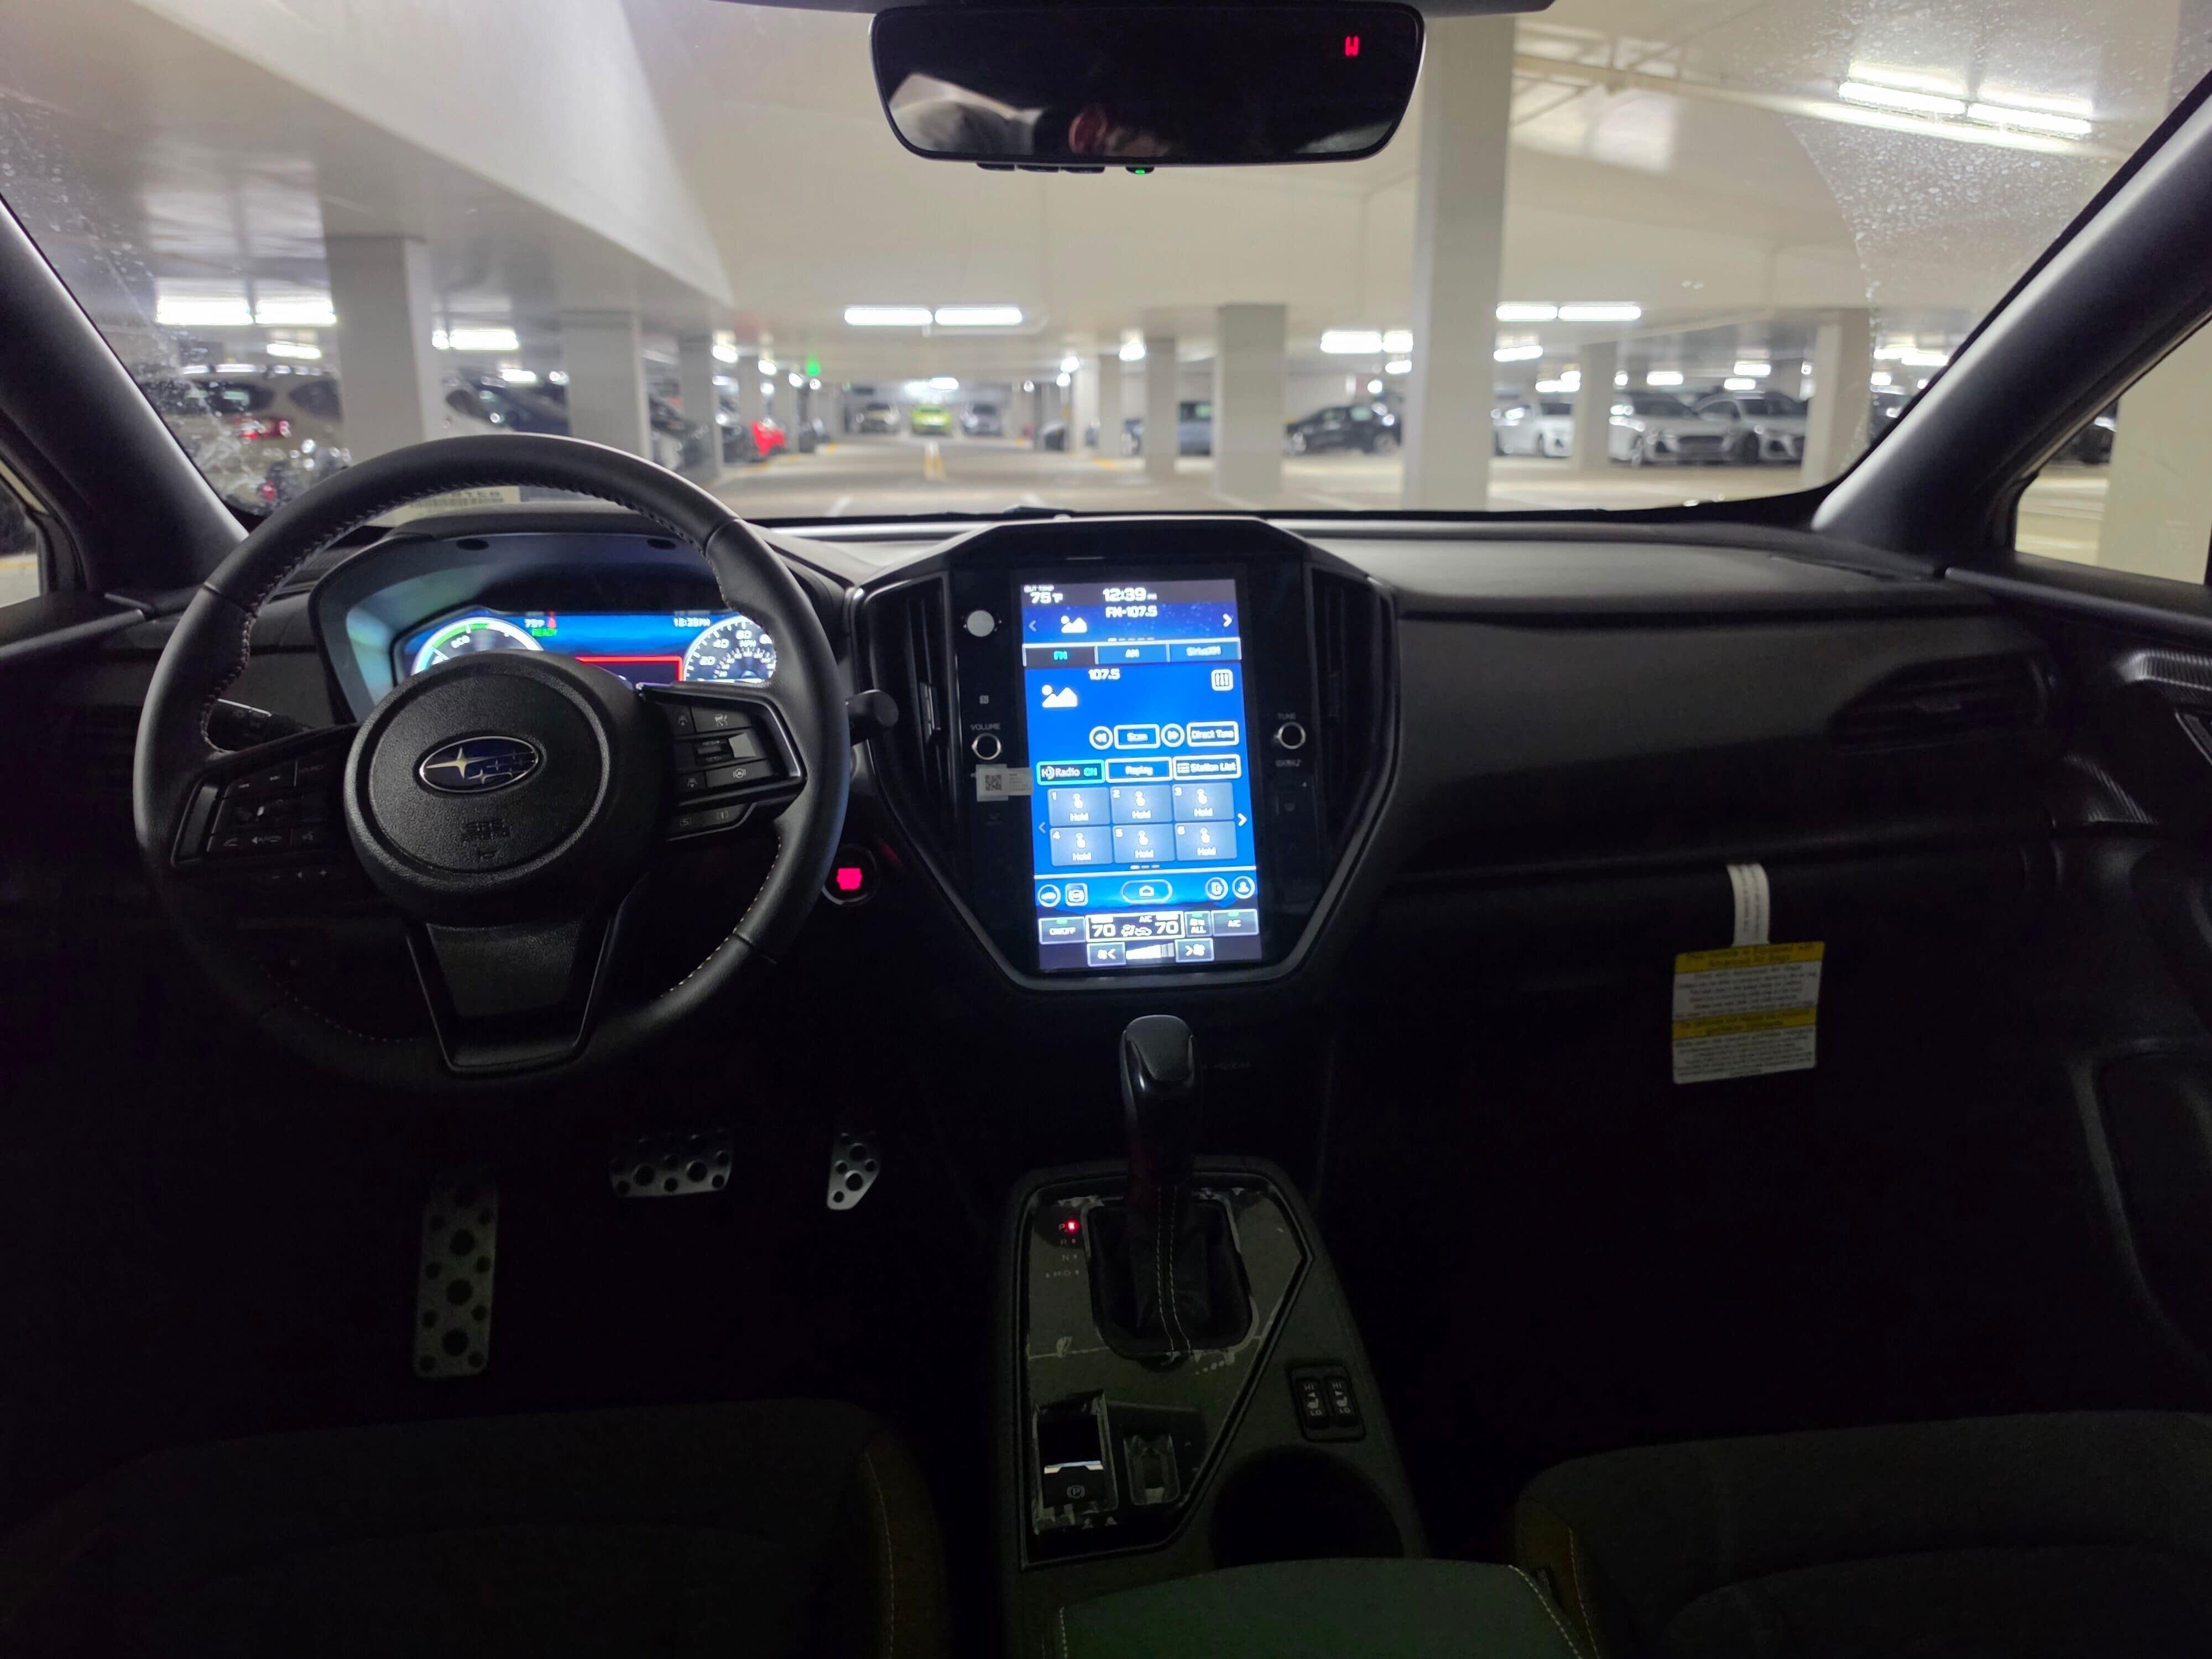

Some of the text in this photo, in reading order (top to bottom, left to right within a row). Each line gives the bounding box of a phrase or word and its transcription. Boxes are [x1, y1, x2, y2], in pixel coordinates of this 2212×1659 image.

[1103, 587, 1146, 602] 12:39
[1125, 649, 1140, 658] AM
[1088, 668, 1121, 680] 107.5
[970, 723, 1001, 731] VOLUME
[1190, 761, 1237, 773] Station List
[1055, 767, 1081, 778] Radio
[1070, 812, 1089, 822] Hold
[1131, 810, 1151, 820] Hold
[1193, 807, 1213, 817] Hold
[1072, 852, 1092, 861] Hold
[1134, 849, 1154, 858] Hold
[1197, 847, 1217, 856] Hold
[1092, 924, 1116, 937] 70
[1155, 921, 1179, 935] 70
